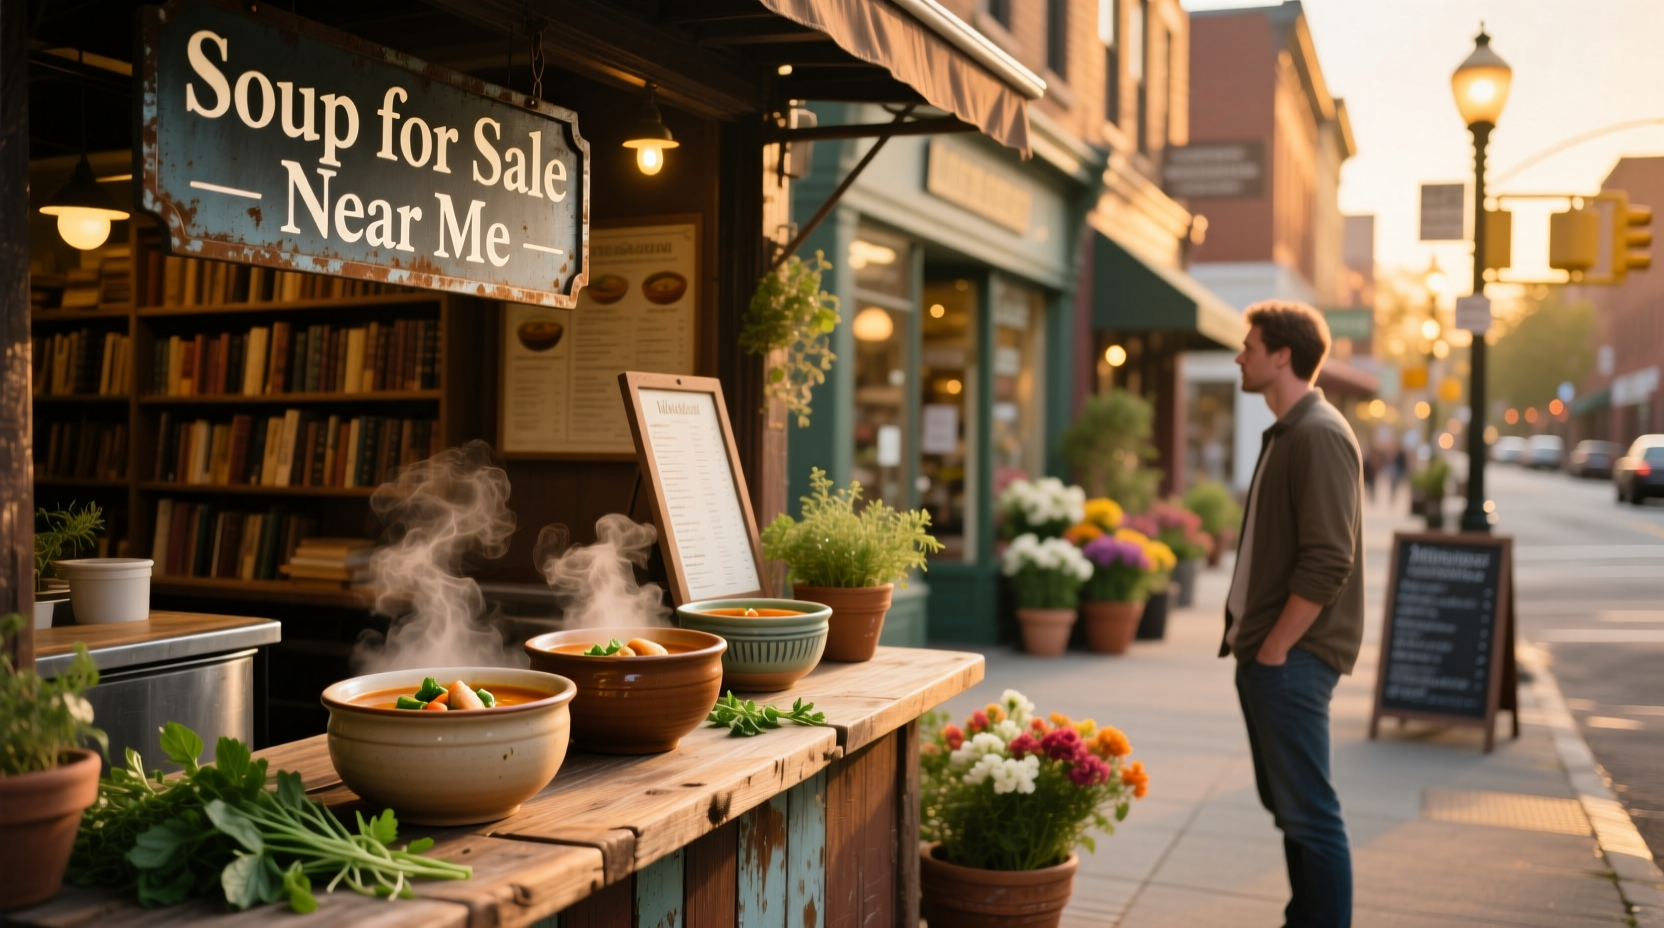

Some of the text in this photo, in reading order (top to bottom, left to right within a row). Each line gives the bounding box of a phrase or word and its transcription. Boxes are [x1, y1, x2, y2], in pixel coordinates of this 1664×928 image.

[186, 30, 568, 203] Soup for Sale
[280, 159, 511, 267] Near Me
